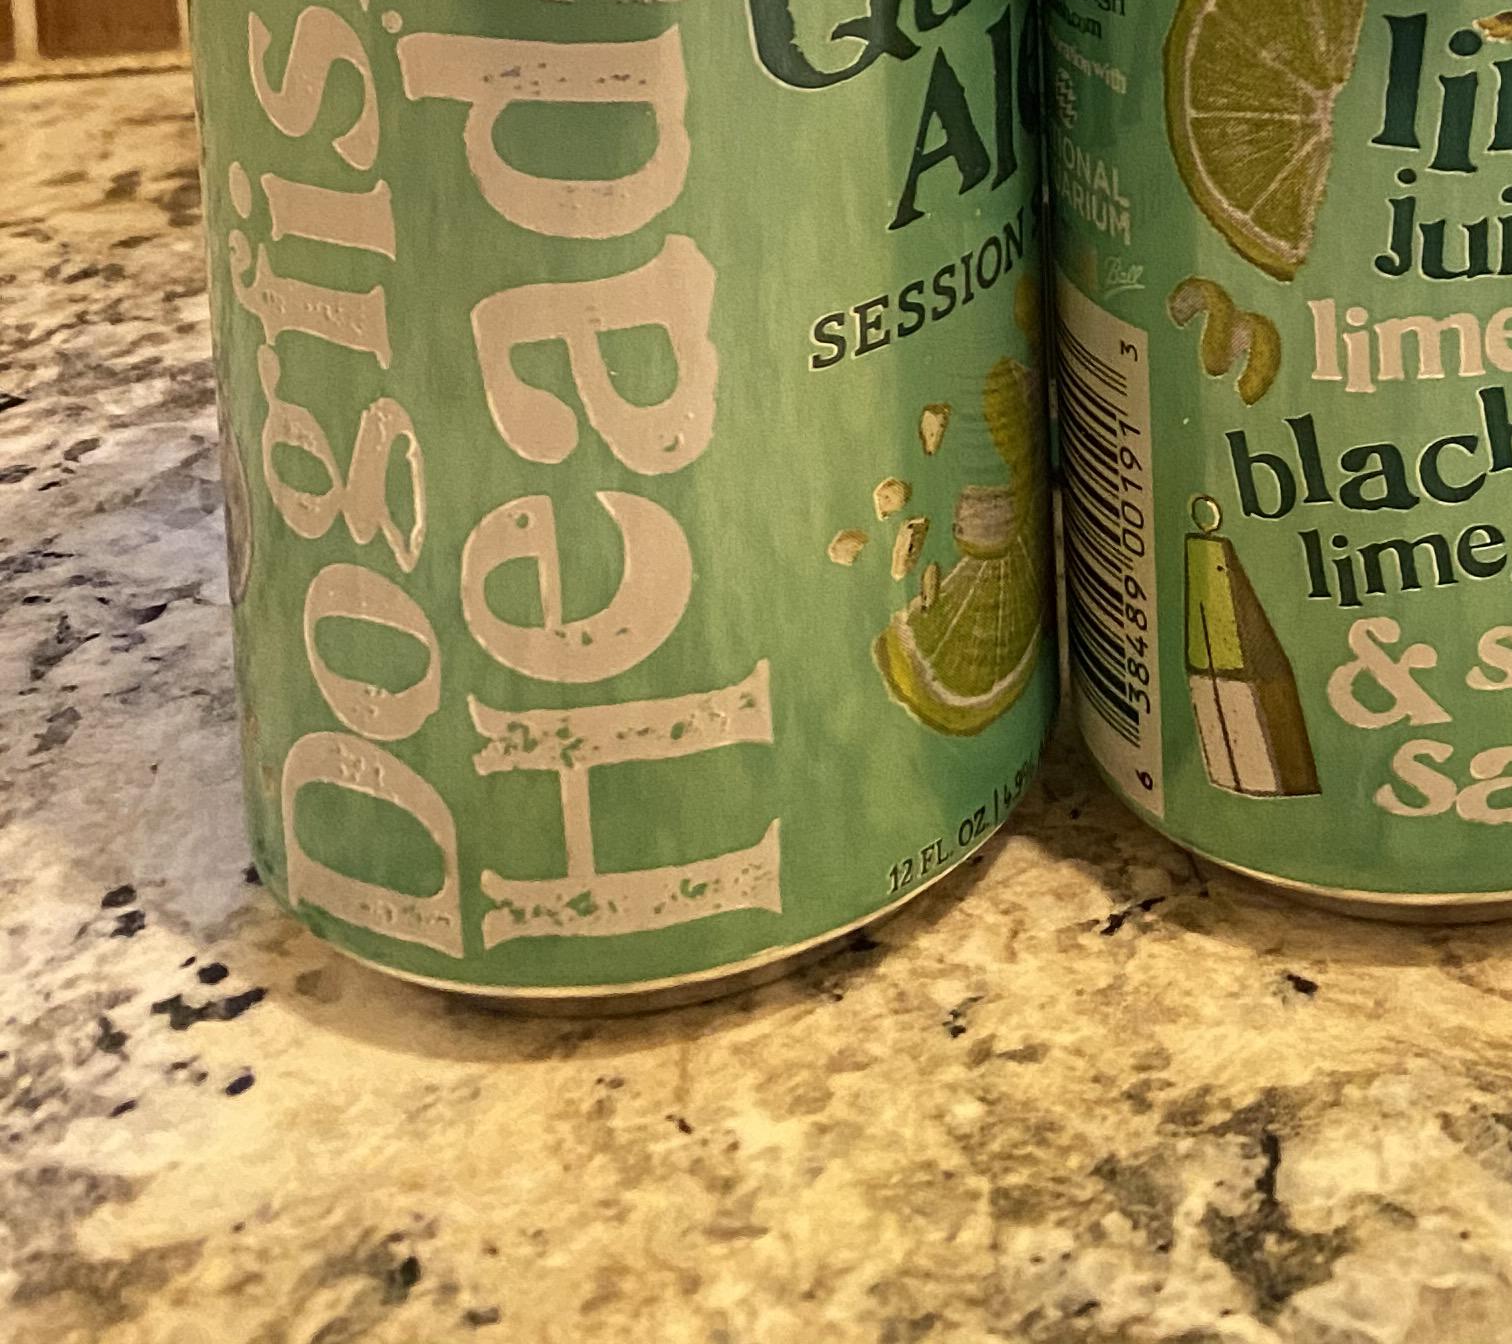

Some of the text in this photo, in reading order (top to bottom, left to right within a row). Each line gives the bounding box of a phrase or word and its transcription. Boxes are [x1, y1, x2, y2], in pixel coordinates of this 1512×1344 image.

[810, 207, 1026, 371] SESSION
[397, 20, 782, 952] Head
[1118, 423, 1146, 557] 00191
[1123, 573, 1152, 715] 38489
[1326, 616, 1453, 730] &
[887, 857, 913, 895] 12
